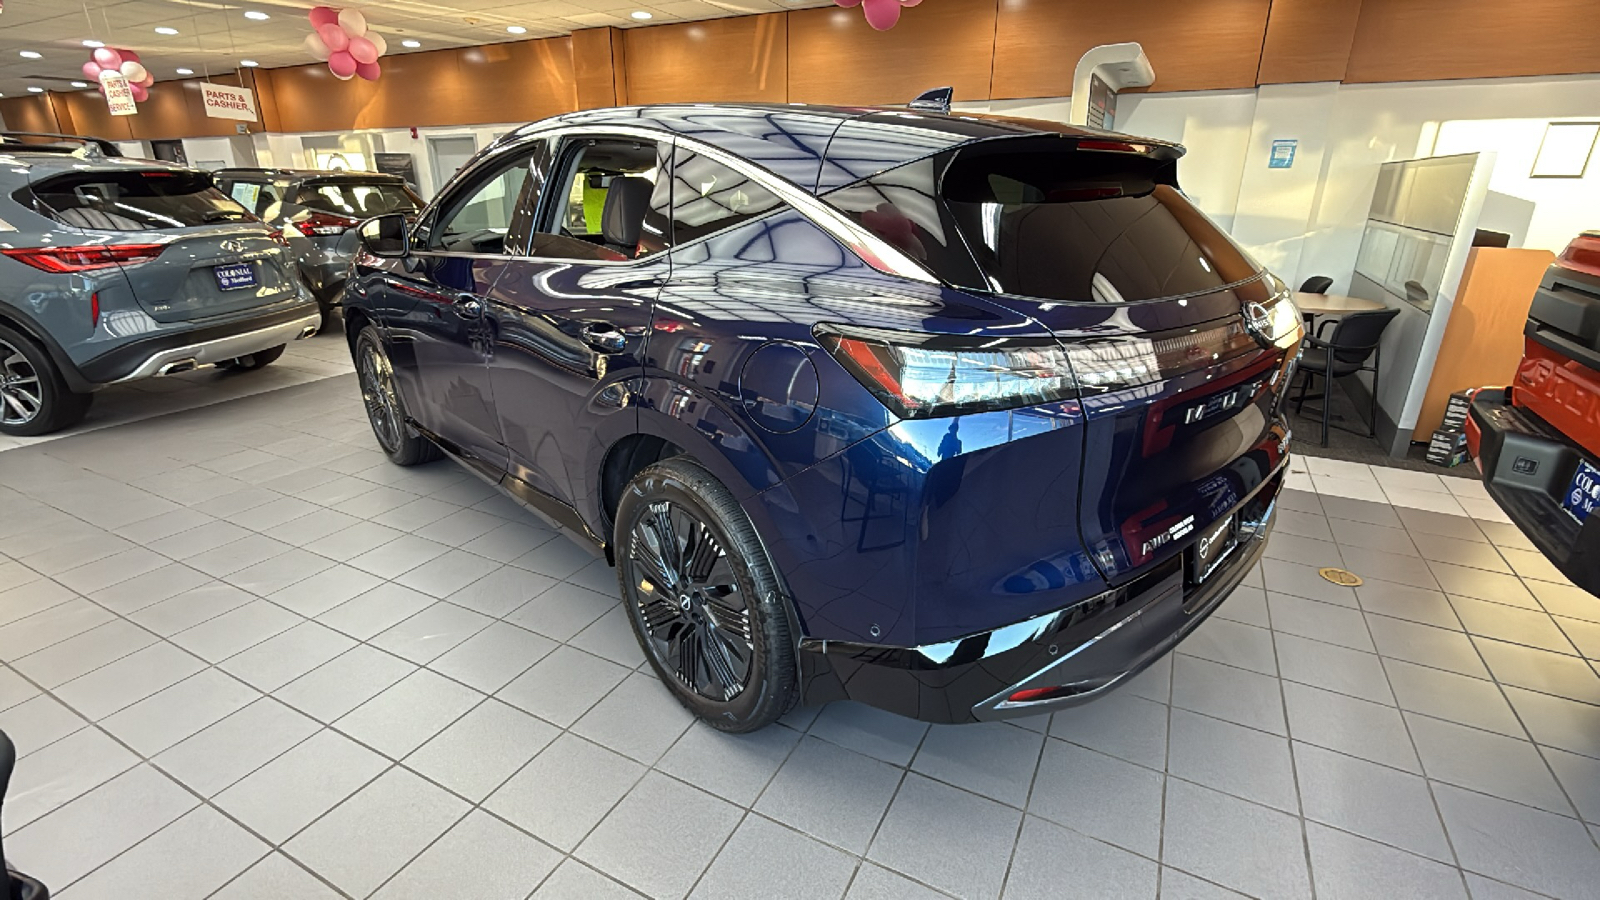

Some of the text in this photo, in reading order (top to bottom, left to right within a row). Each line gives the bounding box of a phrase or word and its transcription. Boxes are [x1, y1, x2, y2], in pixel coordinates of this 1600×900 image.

[106, 80, 123, 89] PARTS
[108, 87, 131, 98] CASHIER
[206, 90, 246, 102] PARTS &
[109, 103, 131, 112] SERVICE
[206, 99, 248, 111] CASHIER
[217, 268, 252, 278] COLONIAL
